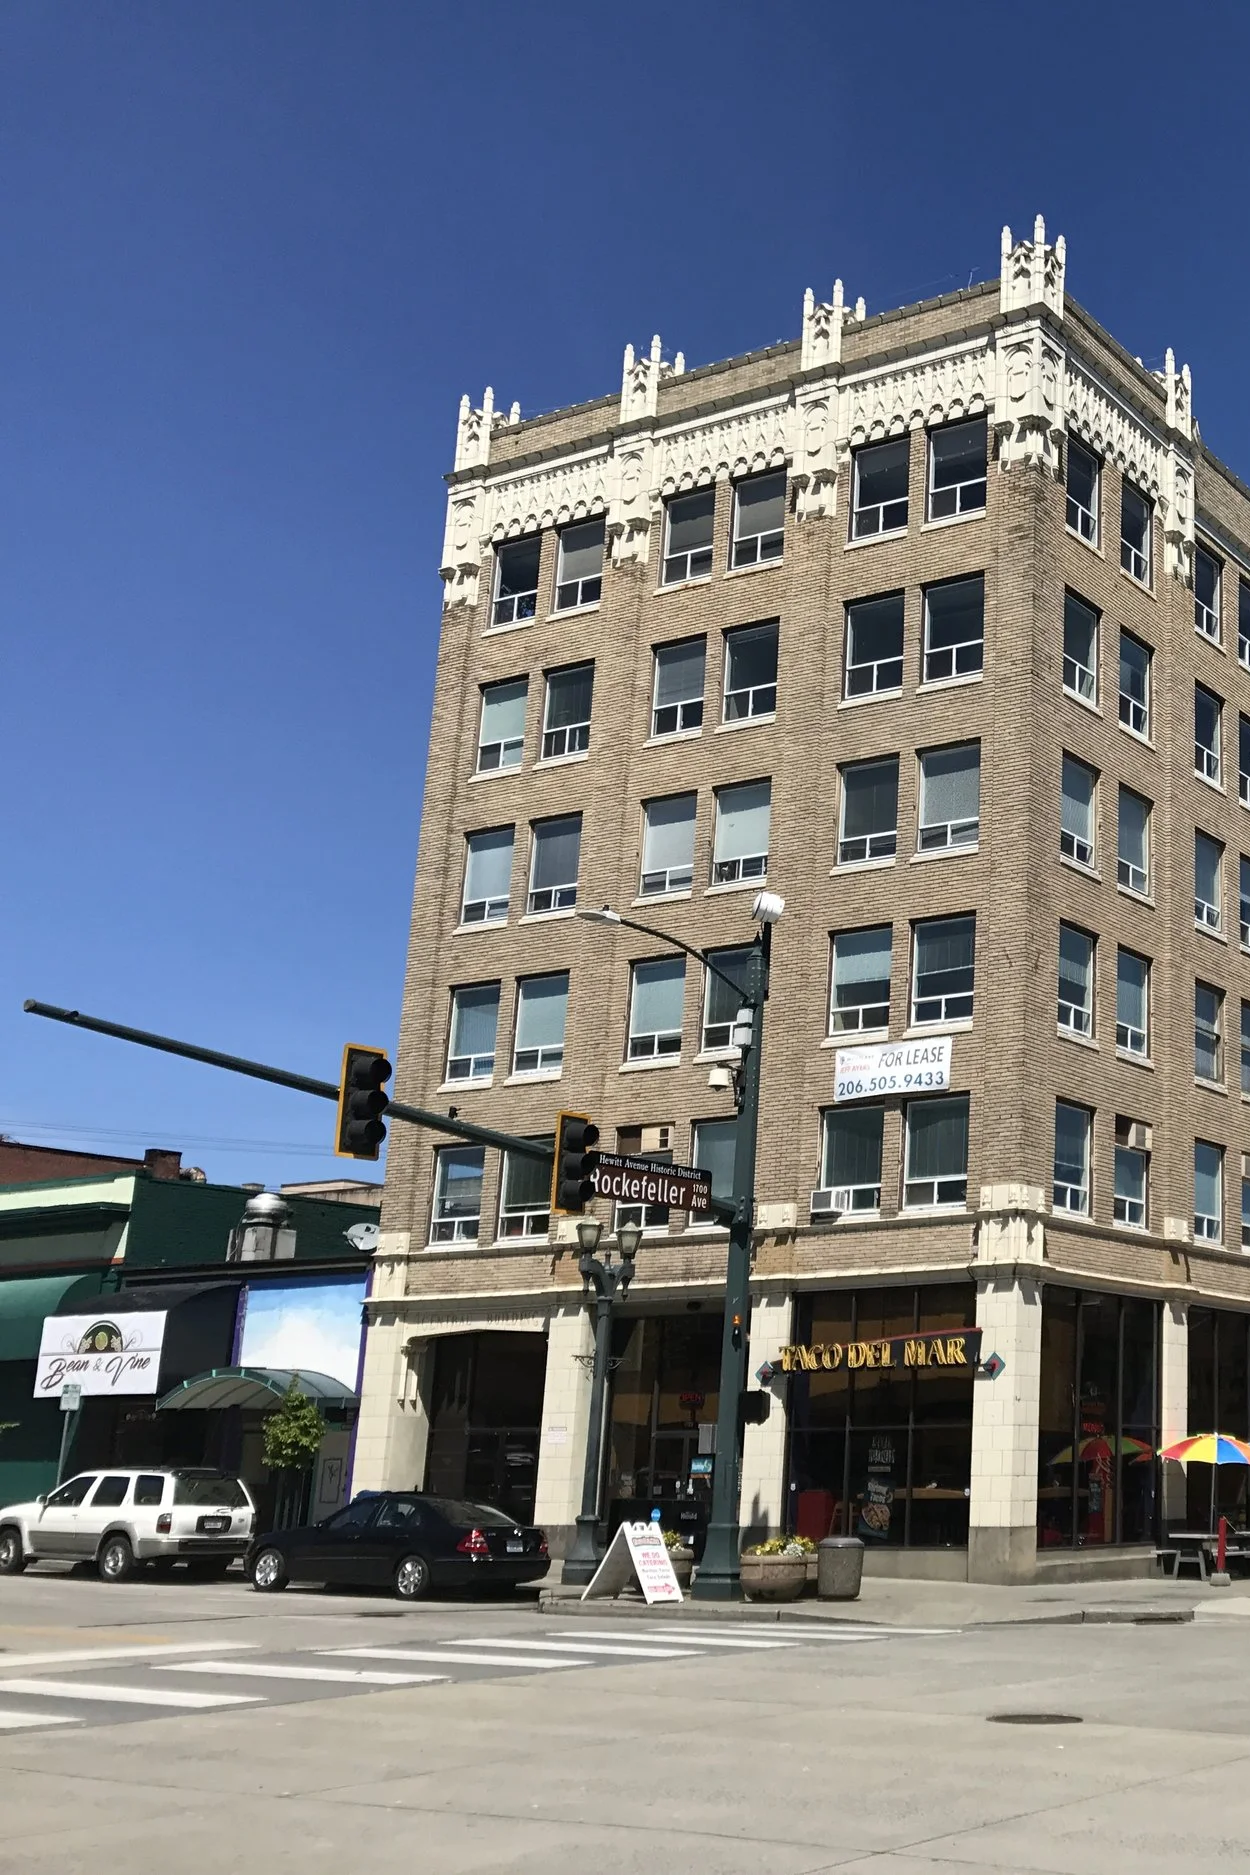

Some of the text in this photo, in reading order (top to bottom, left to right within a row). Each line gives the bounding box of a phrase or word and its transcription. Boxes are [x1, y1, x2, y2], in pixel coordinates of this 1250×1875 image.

[878, 1051, 903, 1068] FOR
[905, 1046, 944, 1066] LEASE
[838, 1071, 944, 1096] 206.505.9433
[600, 1154, 701, 1180] Hewitt Avenue Historic District
[691, 1194, 707, 1209] Ave
[692, 1183, 708, 1195] 1700
[779, 1337, 967, 1371] TACO DEL MAR
[40, 1353, 151, 1391] Bean & Vine
